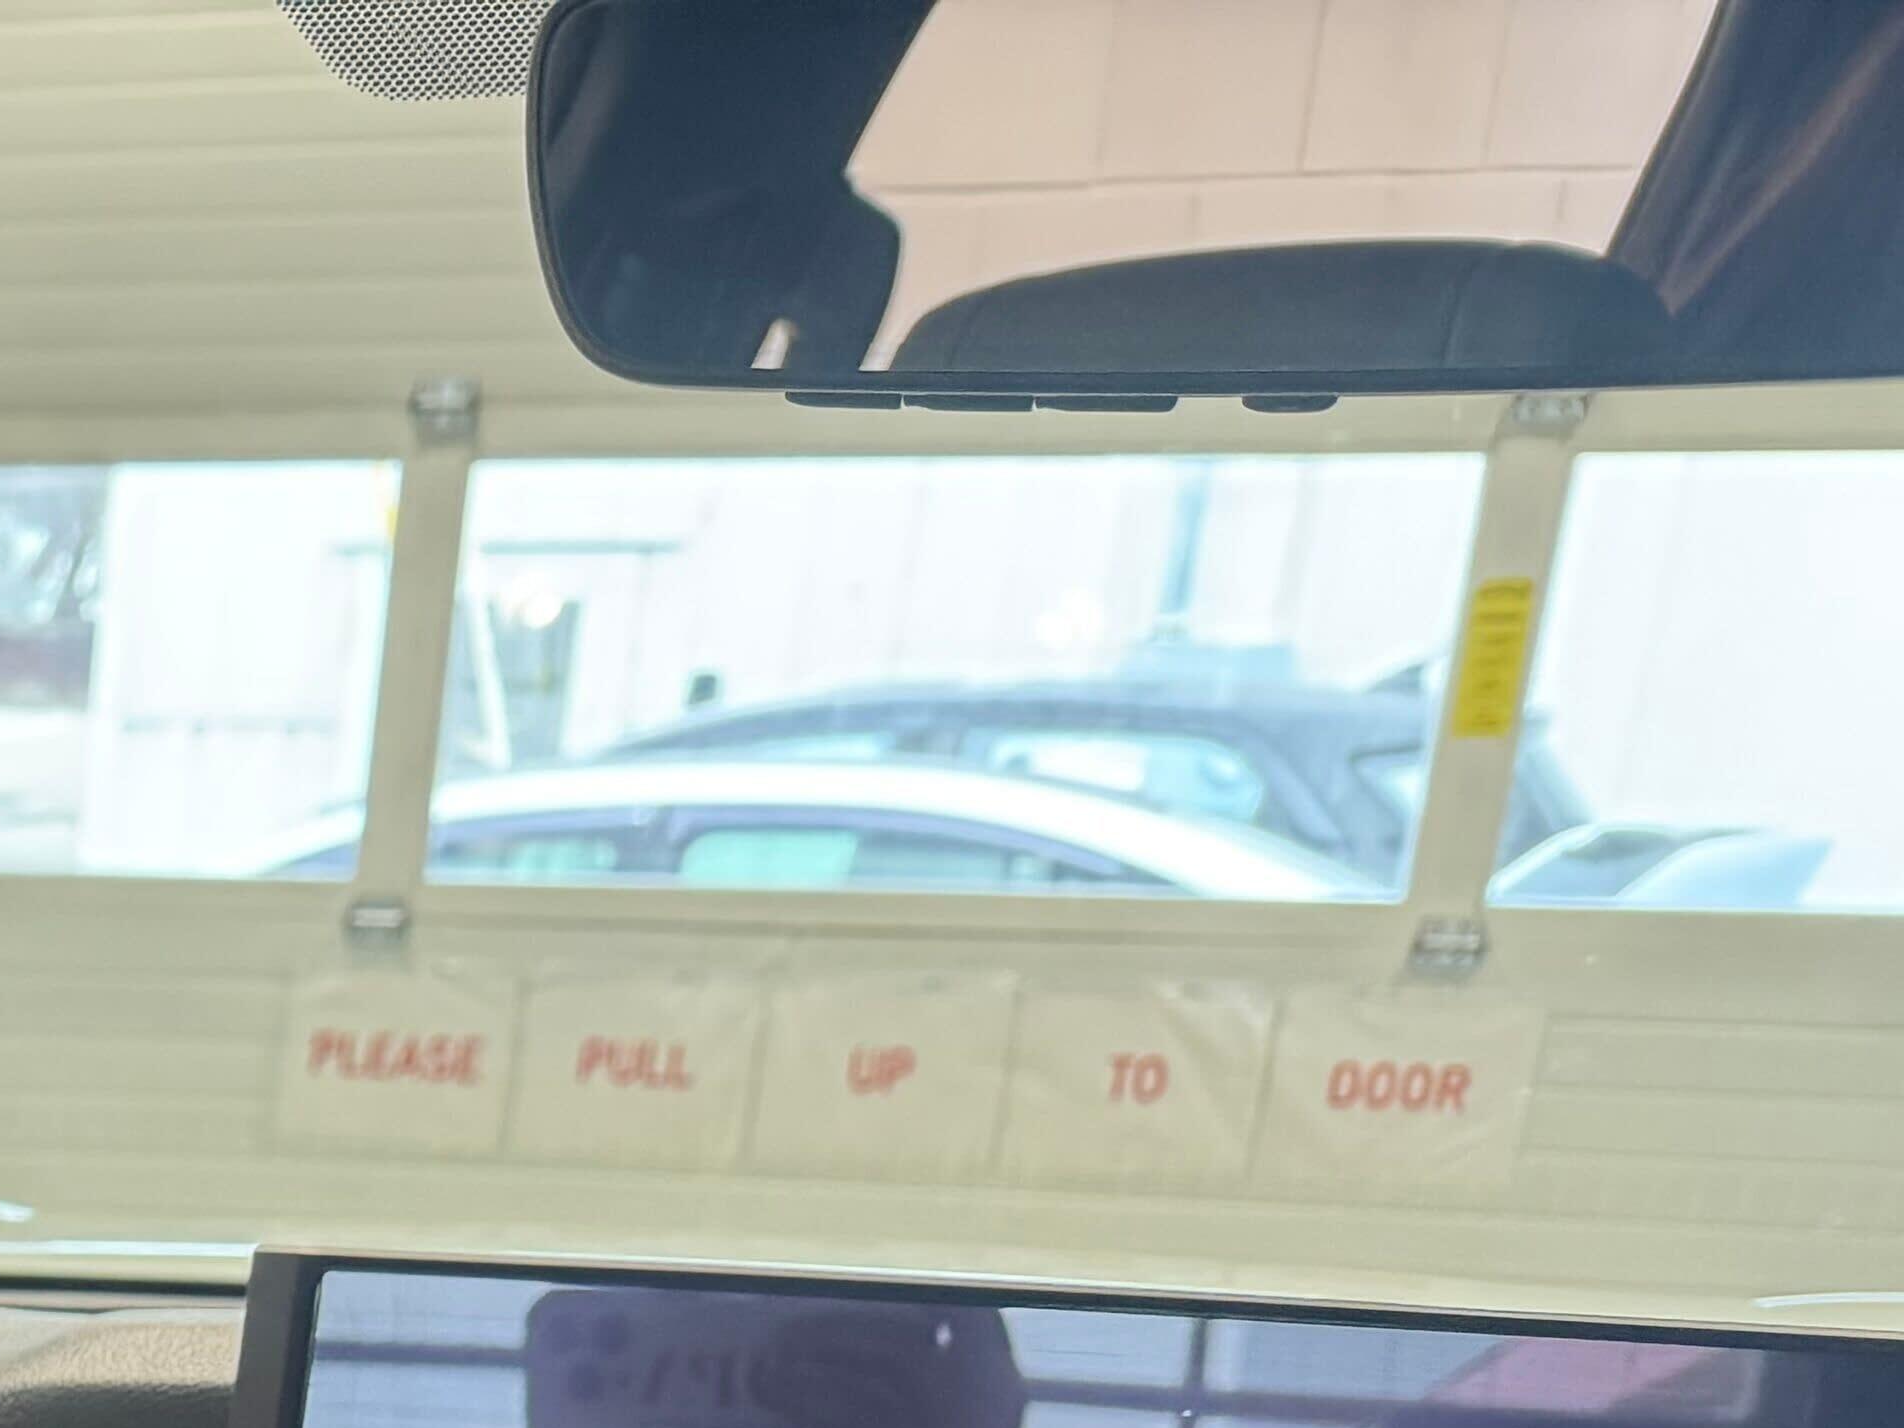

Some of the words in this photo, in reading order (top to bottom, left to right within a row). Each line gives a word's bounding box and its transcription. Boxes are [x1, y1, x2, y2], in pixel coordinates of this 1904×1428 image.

[308, 1028, 485, 1087] PLEASE
[576, 1035, 694, 1091] PULL
[846, 1045, 917, 1096] UP
[1108, 1052, 1169, 1105] TO
[1326, 1060, 1472, 1114] DOOR
